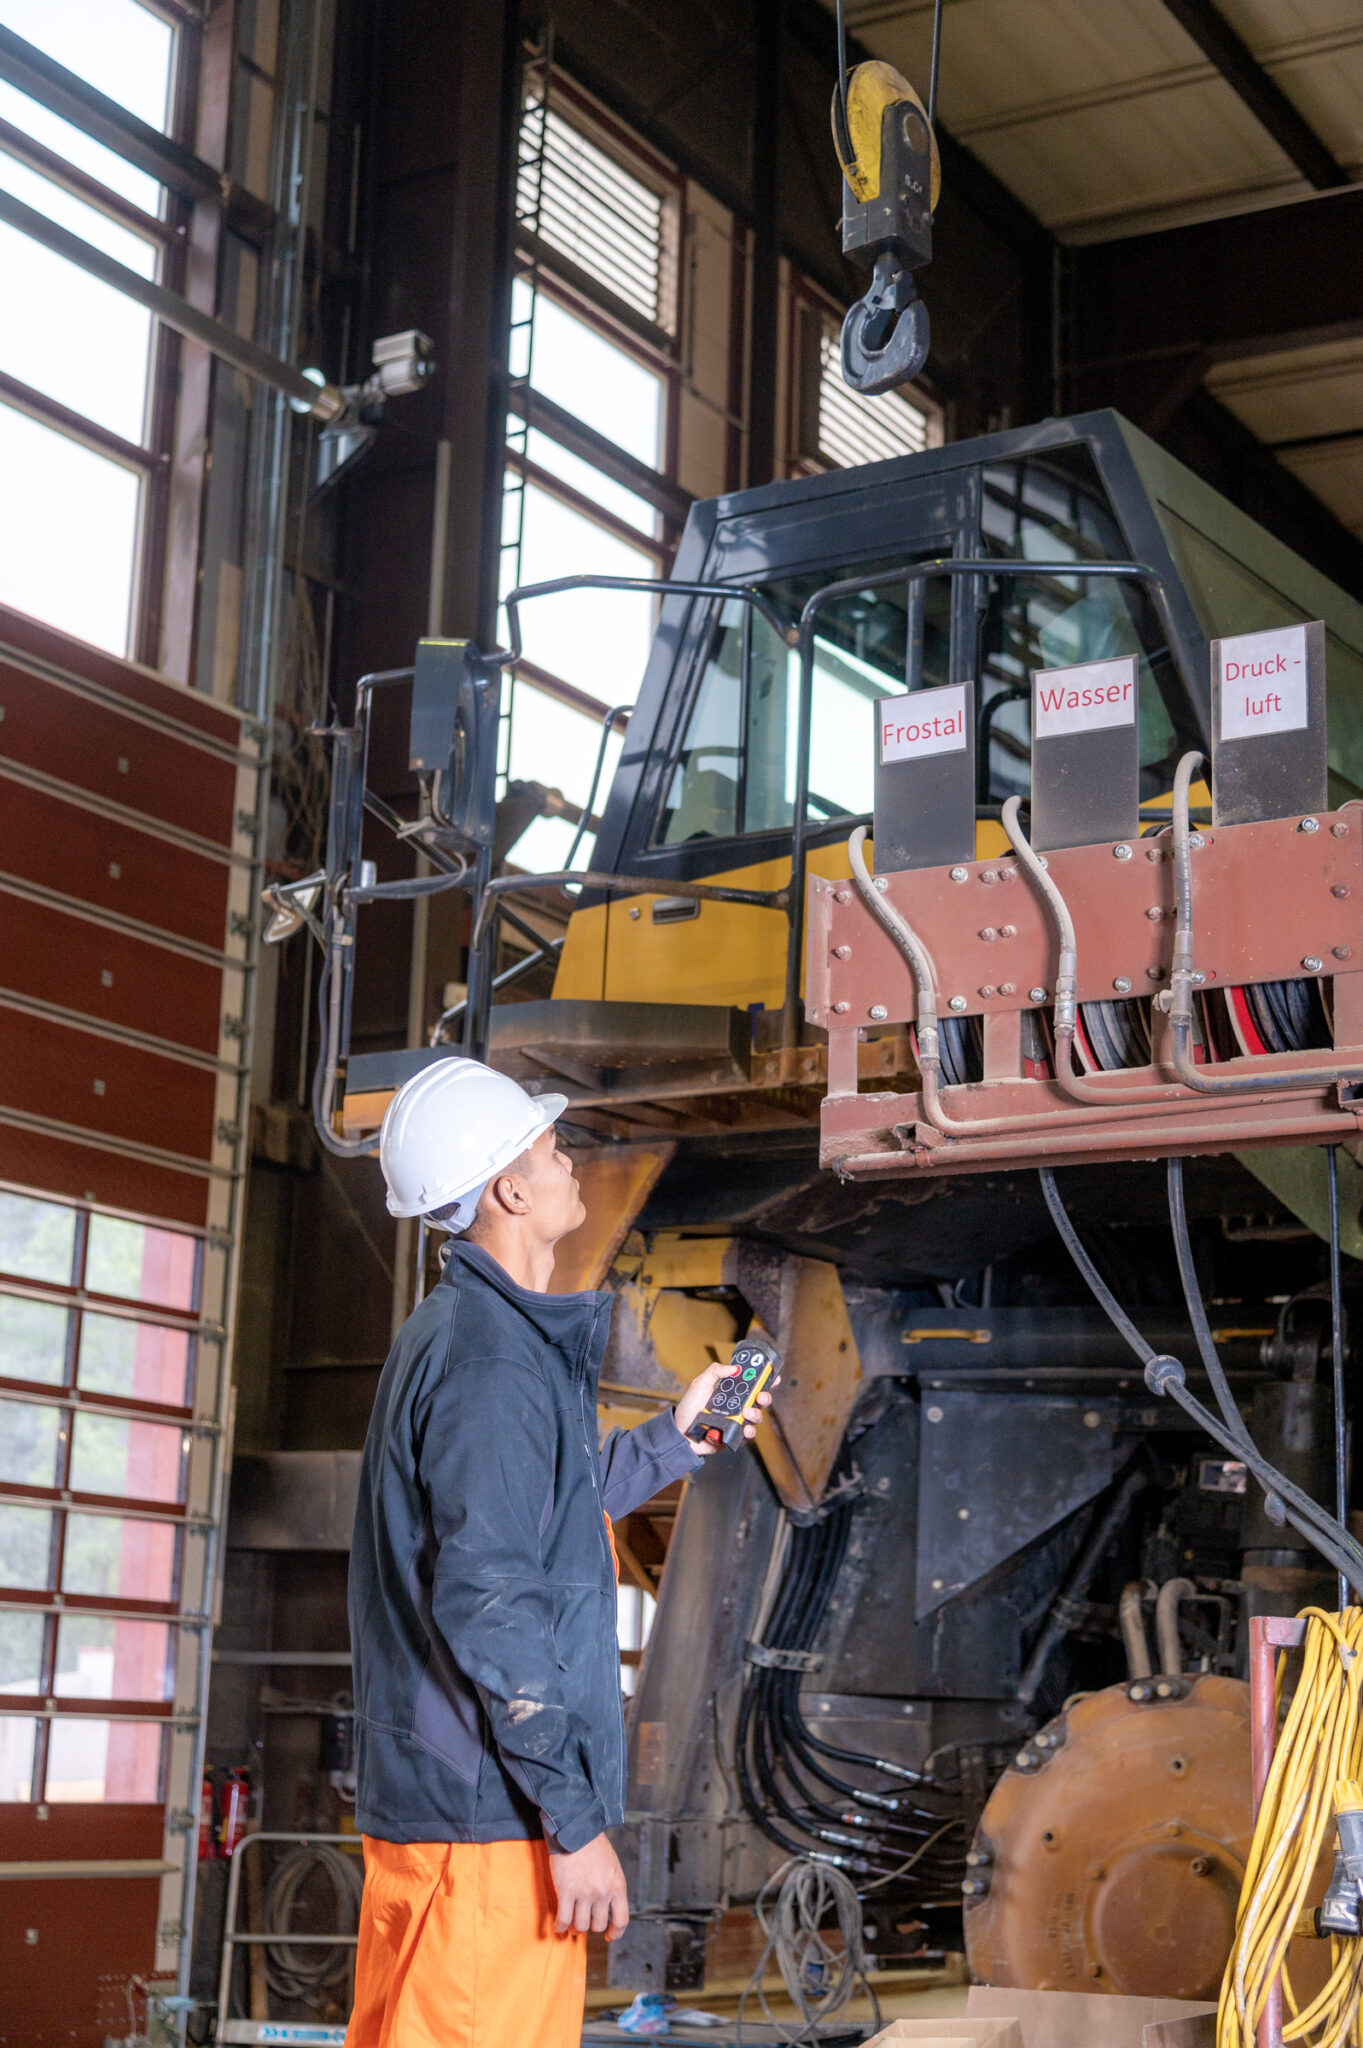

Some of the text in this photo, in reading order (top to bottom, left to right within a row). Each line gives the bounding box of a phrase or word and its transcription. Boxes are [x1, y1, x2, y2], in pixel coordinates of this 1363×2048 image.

[1225, 653, 1287, 682] Druck
[1039, 683, 1133, 713] Wasser
[1245, 692, 1281, 717] luft
[883, 710, 963, 746] Frostal
